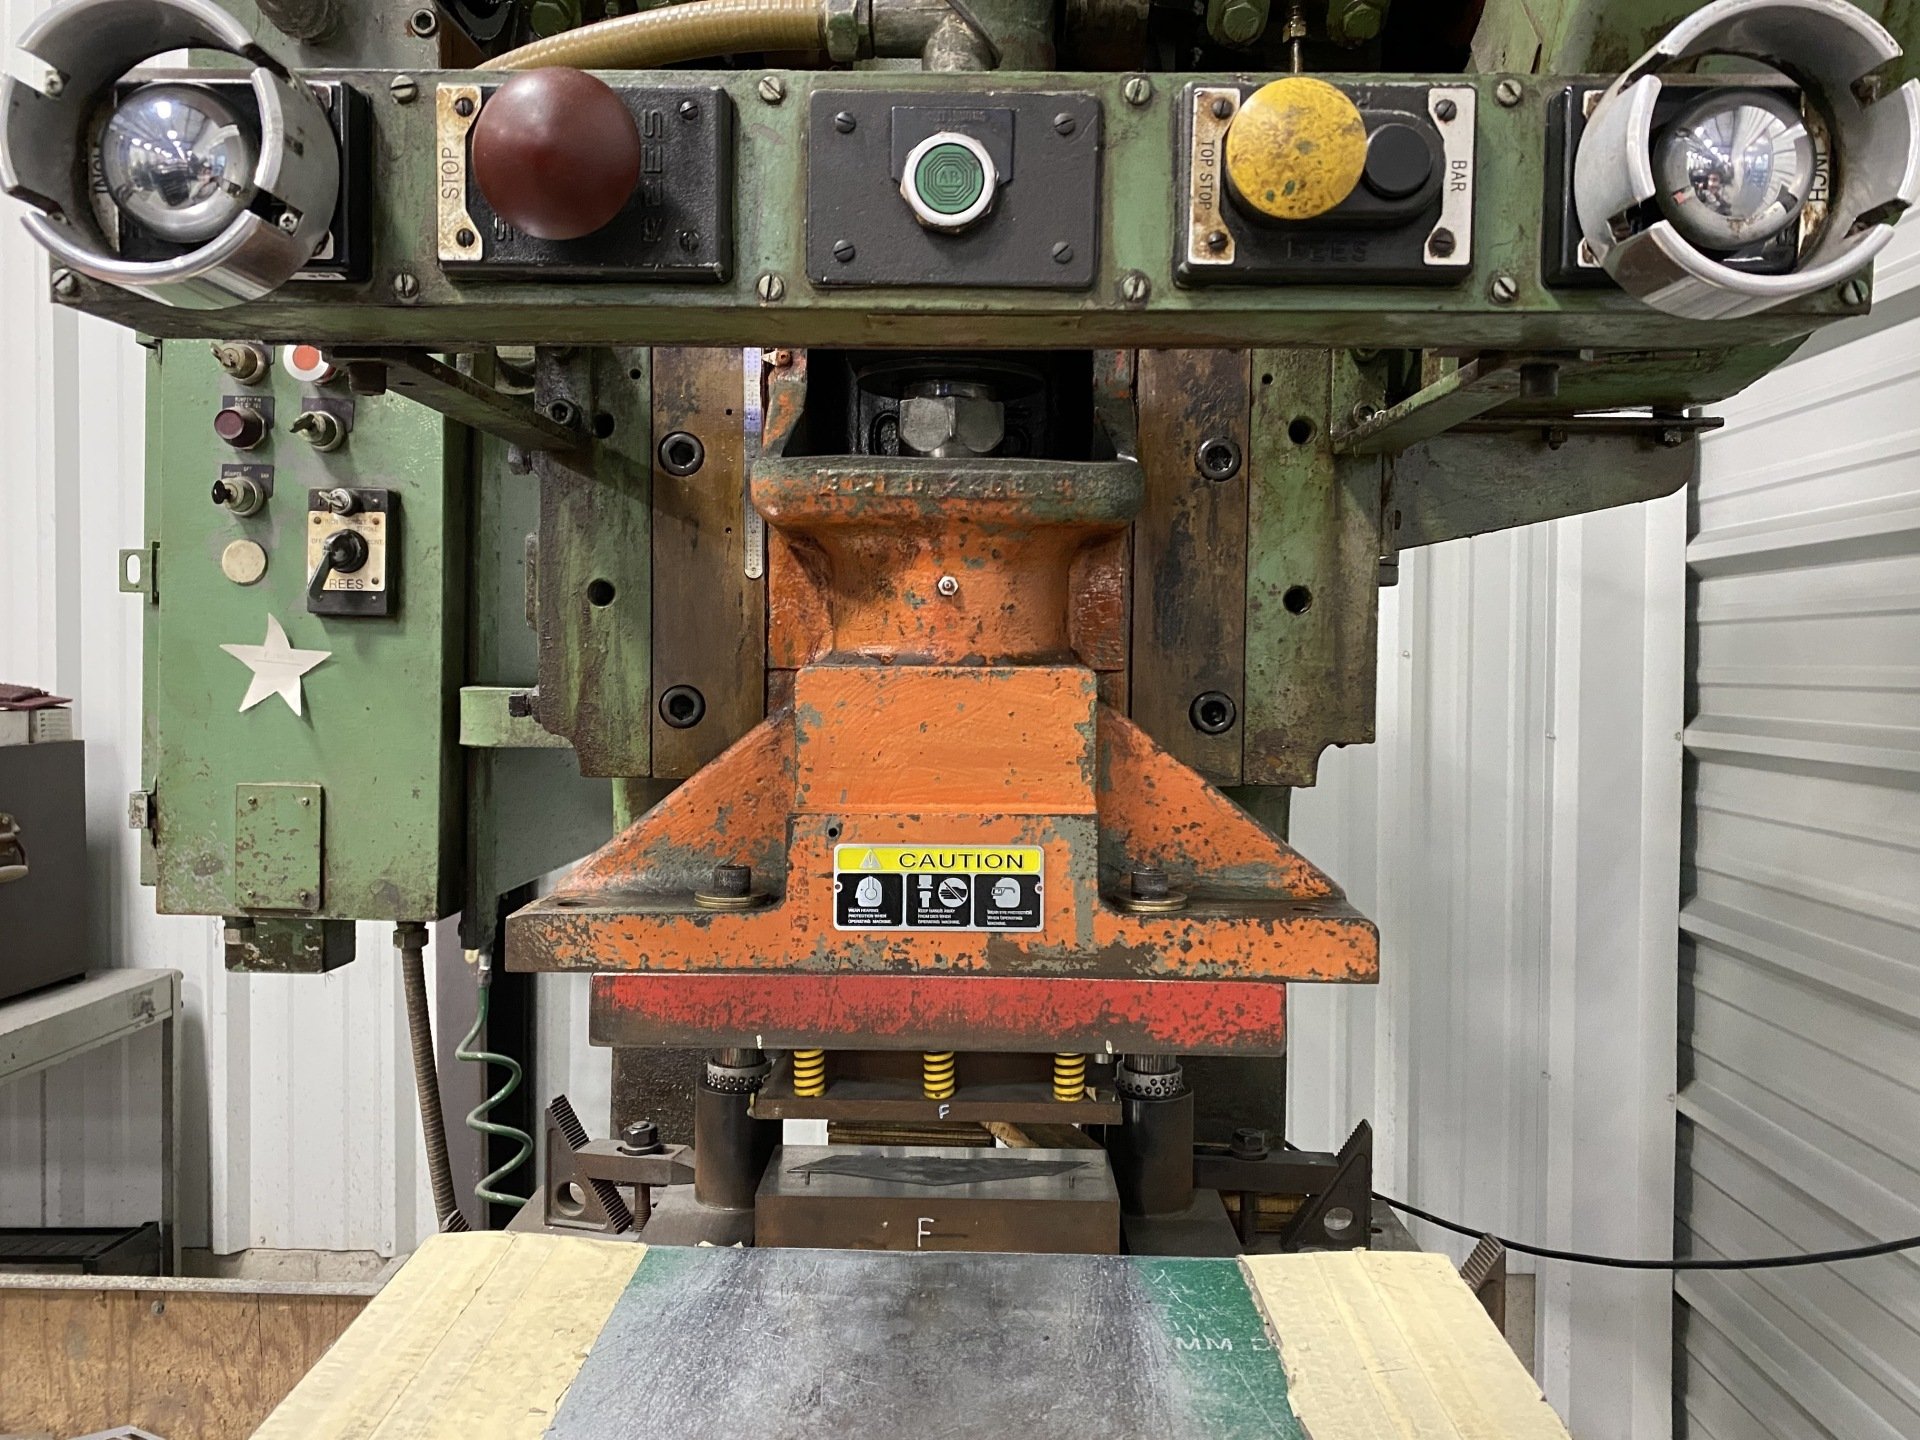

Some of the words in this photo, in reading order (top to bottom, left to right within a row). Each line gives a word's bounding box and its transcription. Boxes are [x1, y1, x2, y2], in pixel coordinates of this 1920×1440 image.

[1200, 140, 1215, 168] TOP
[441, 147, 460, 200] STOP
[1451, 160, 1467, 192] BAR
[1199, 173, 1213, 211] STOP
[329, 578, 364, 590] REES
[899, 853, 1023, 869] CAUTION
[938, 1103, 950, 1119] F
[917, 1217, 935, 1248] F
